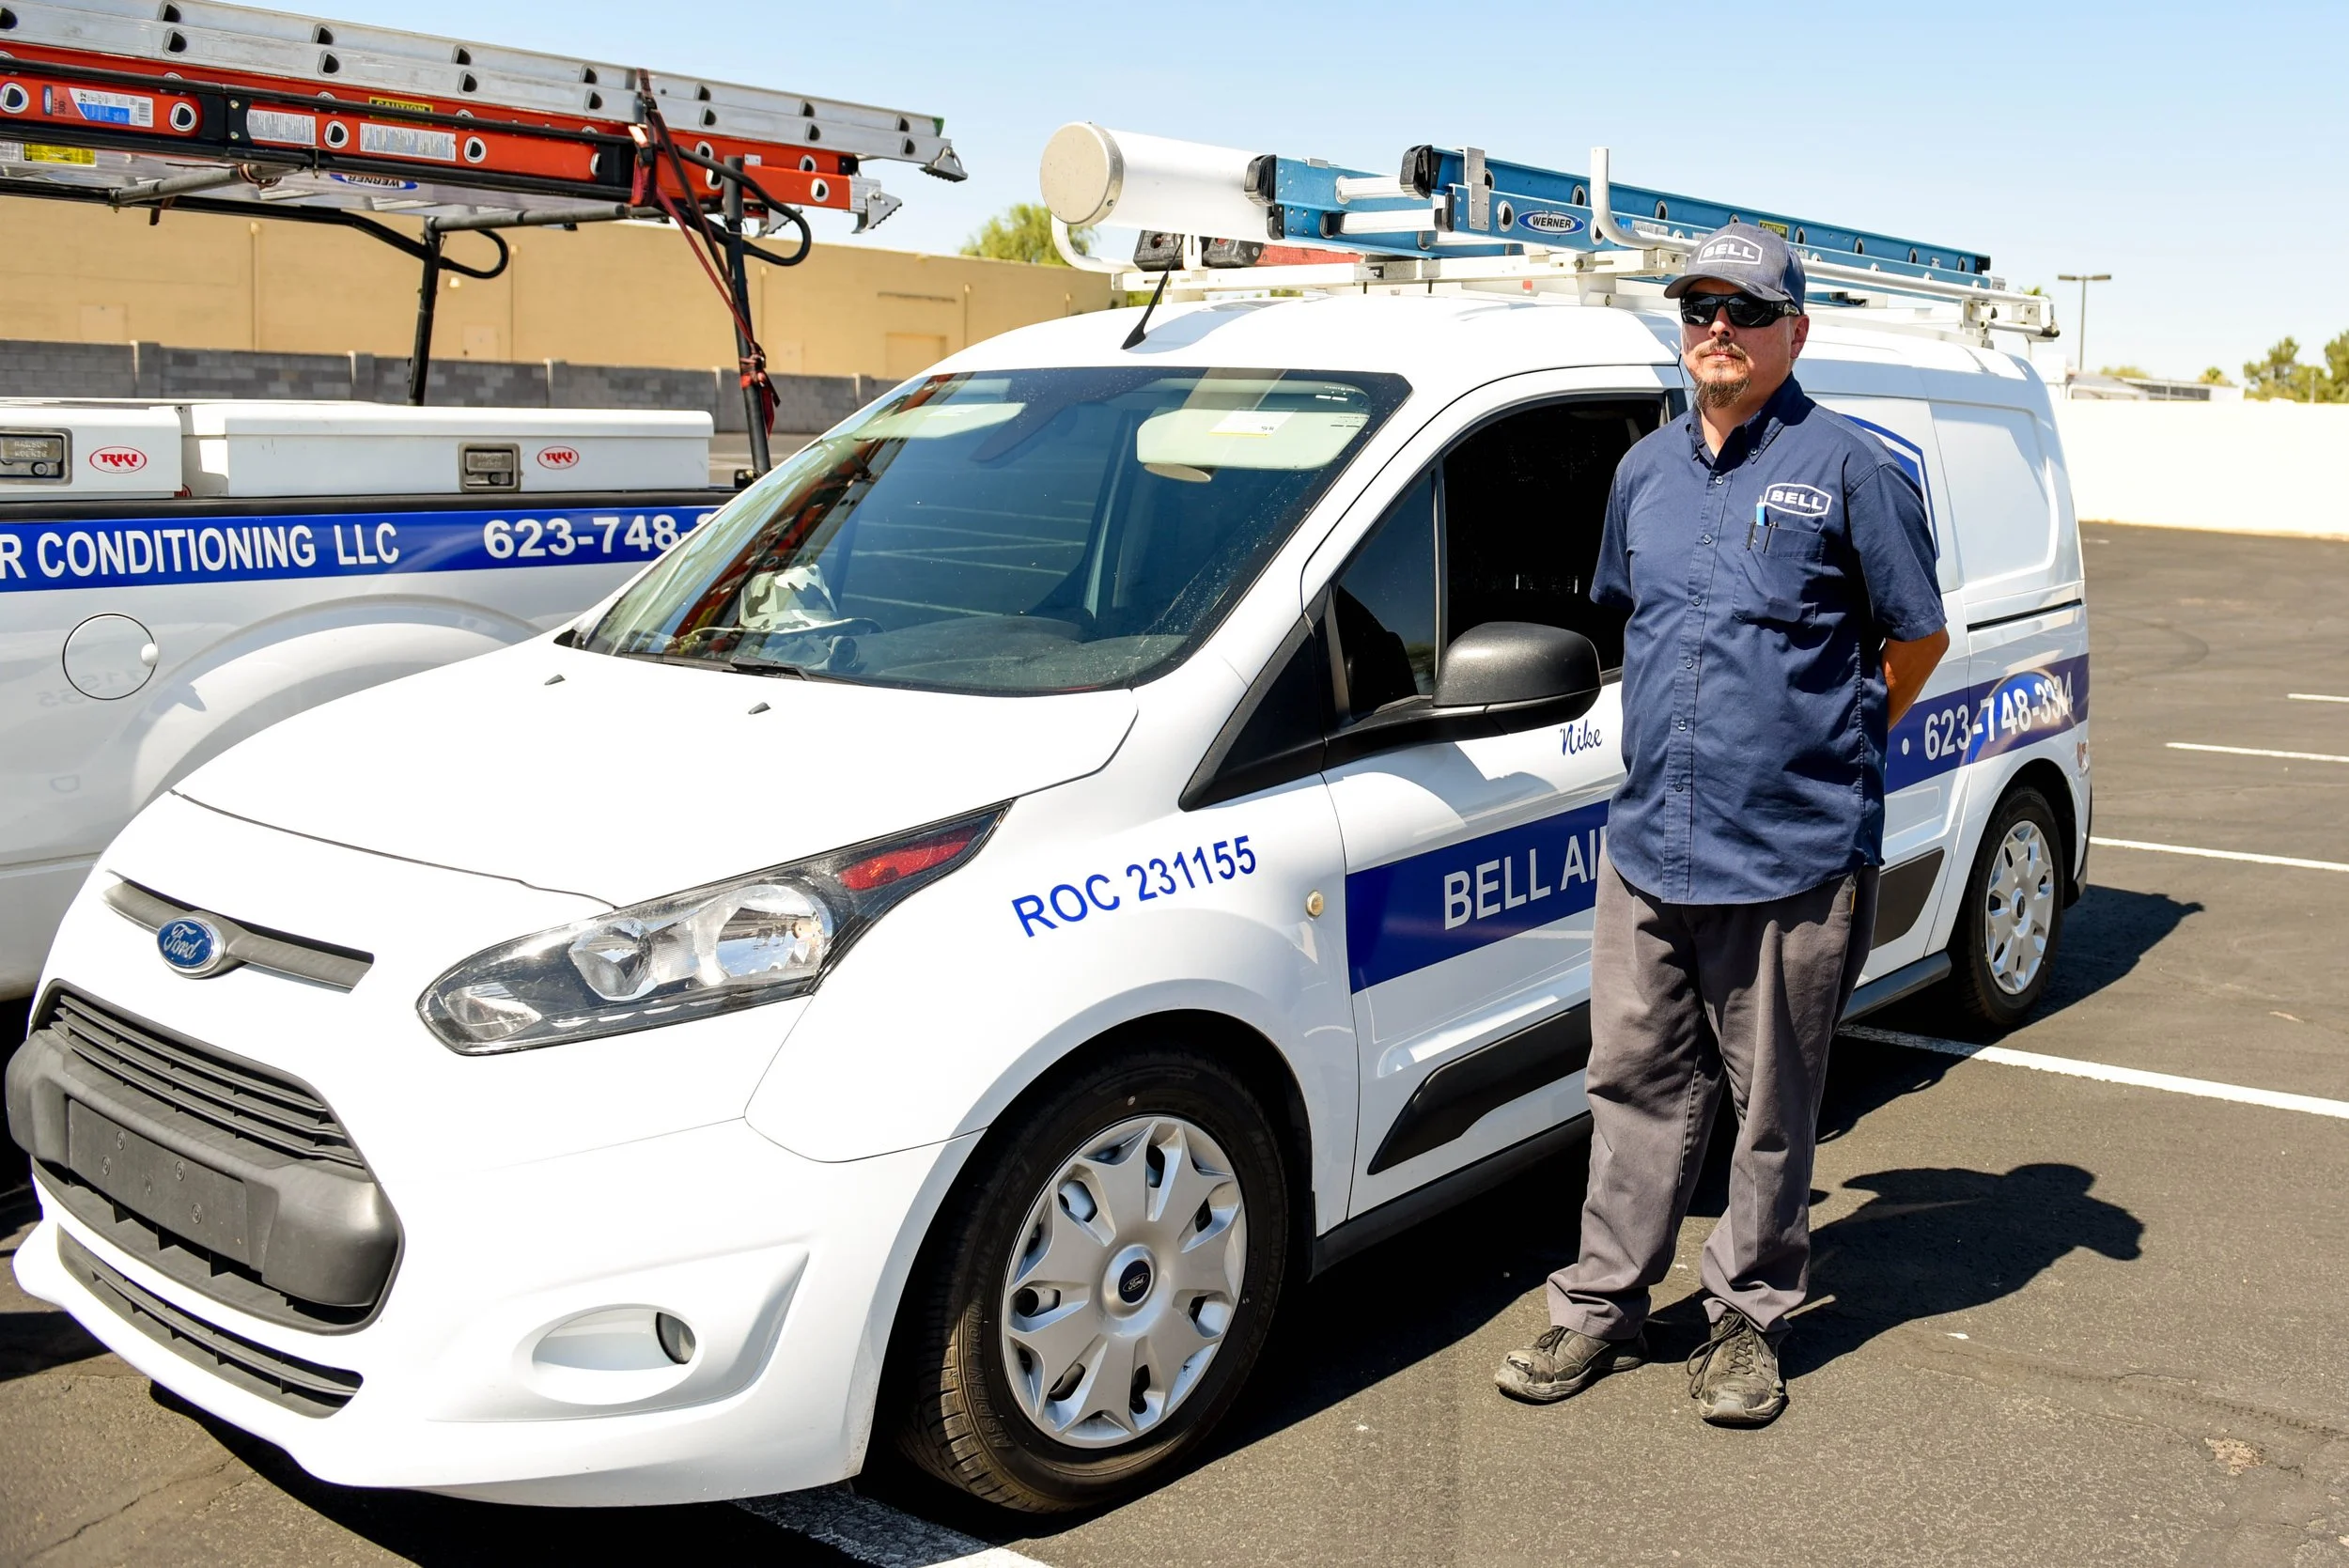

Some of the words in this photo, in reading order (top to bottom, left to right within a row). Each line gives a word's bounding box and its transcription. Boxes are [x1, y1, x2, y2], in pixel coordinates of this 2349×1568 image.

[348, 175, 400, 188] WERNER
[1532, 216, 1572, 228] WERNER
[1703, 243, 1755, 259] BELL
[100, 453, 137, 467] RKI
[545, 452, 572, 464] RKI
[1770, 489, 1823, 510] BELL
[37, 524, 317, 579] CONDITIONING
[334, 522, 399, 566] LLC
[483, 513, 711, 559] 623-748-
[1011, 874, 1121, 938] ROC
[1126, 835, 1256, 902] 231155
[1444, 847, 1551, 930] BELL
[1560, 825, 1608, 892] AI
[163, 924, 203, 960] Ford
